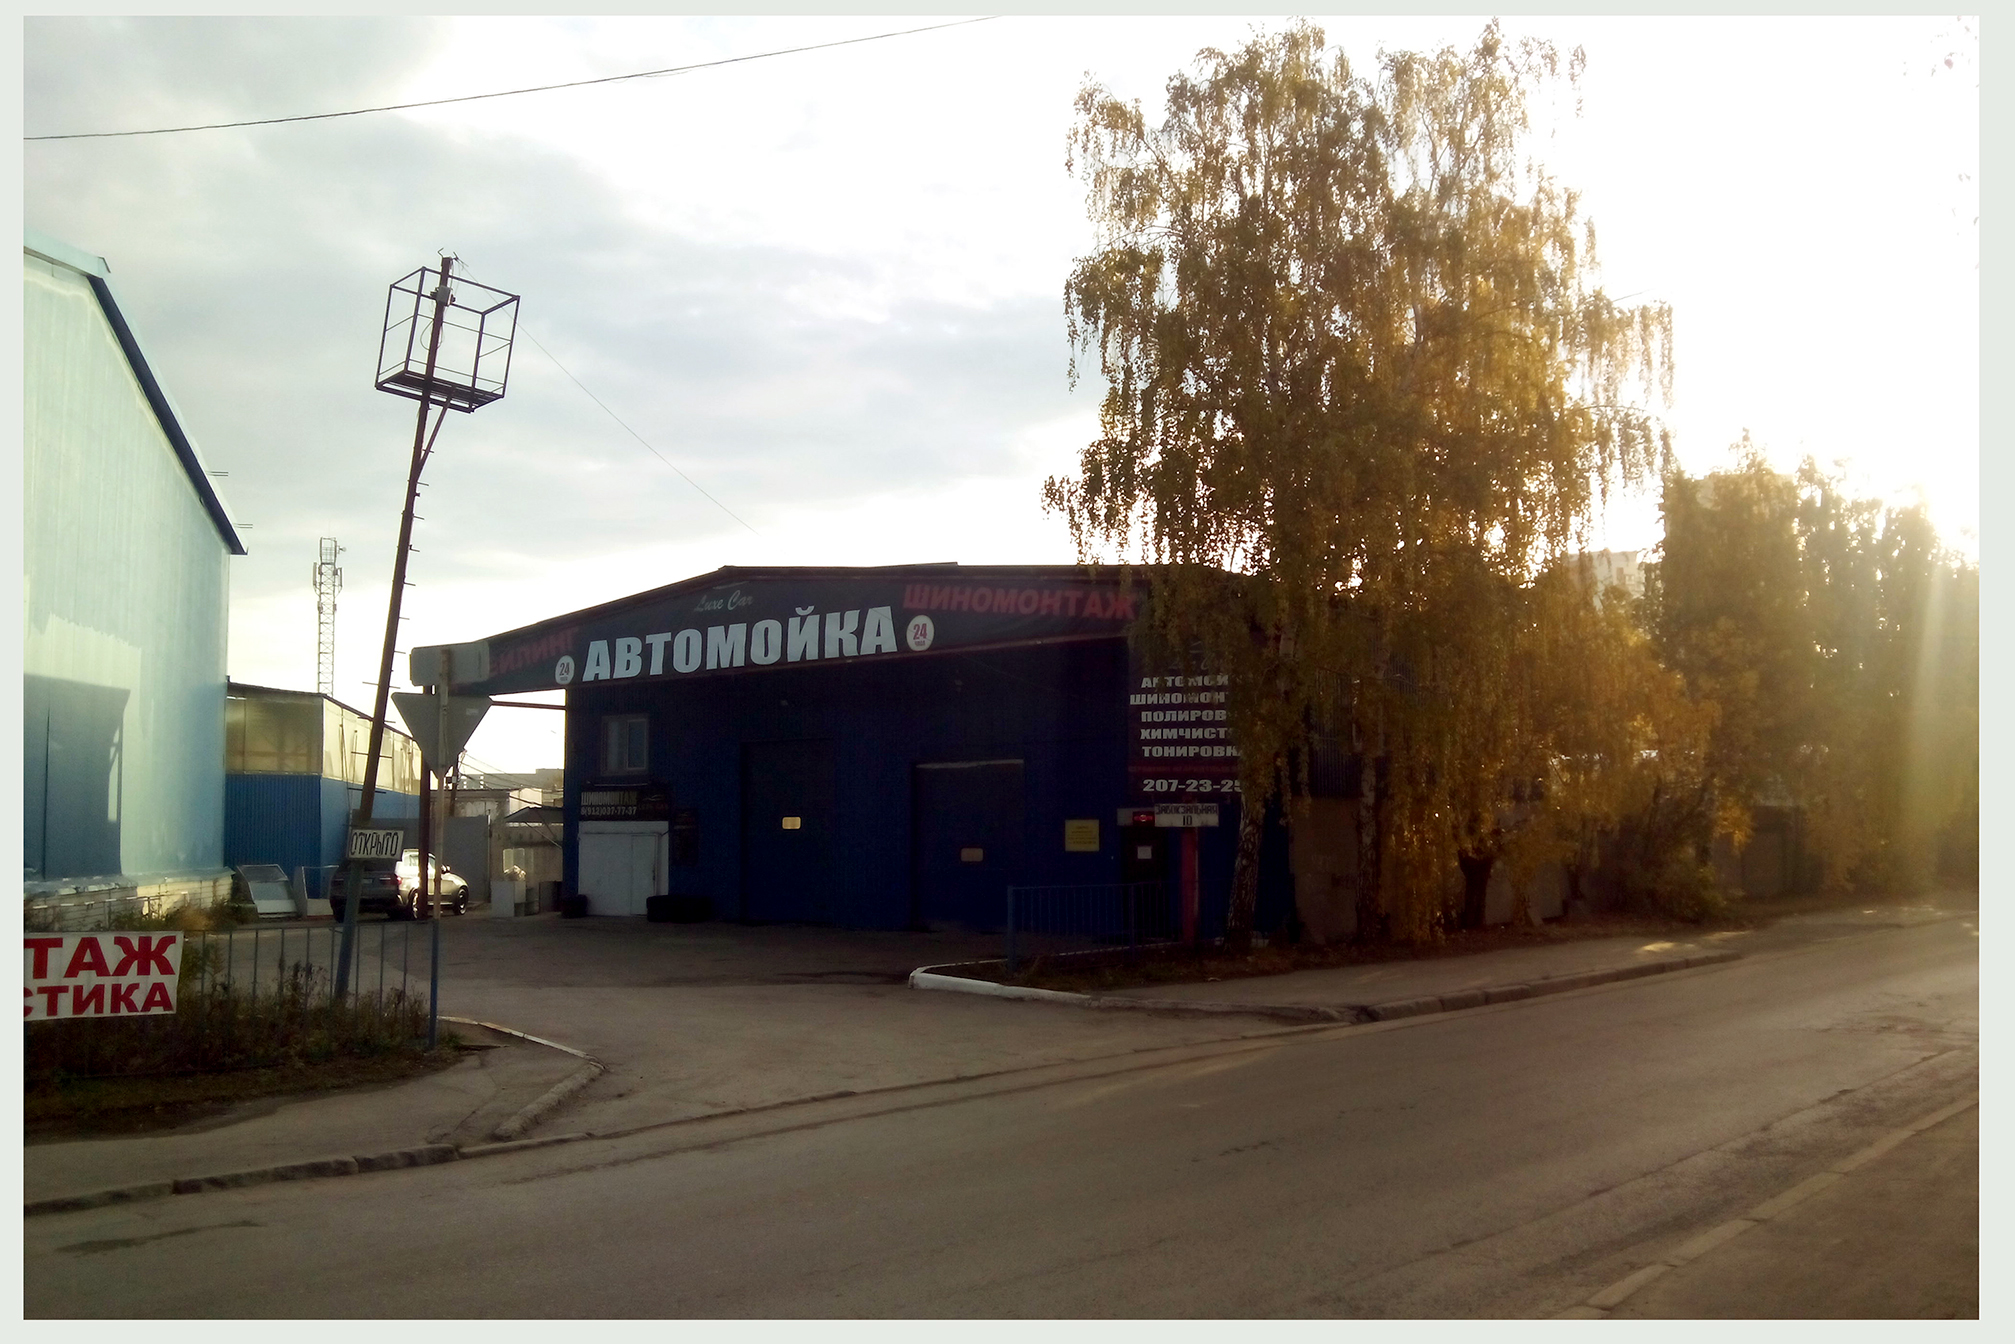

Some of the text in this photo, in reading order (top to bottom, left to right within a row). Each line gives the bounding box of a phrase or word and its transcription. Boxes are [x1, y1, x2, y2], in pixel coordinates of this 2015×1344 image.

[727, 589, 754, 611] Car
[902, 583, 1137, 621] ШИНОМОНТАЖ
[912, 622, 928, 641] 24
[582, 606, 897, 683] АВТОМОЙКА
[558, 662, 570, 676] 24
[1182, 815, 1193, 826] 10
[350, 831, 399, 857] ОТКРЫТО
